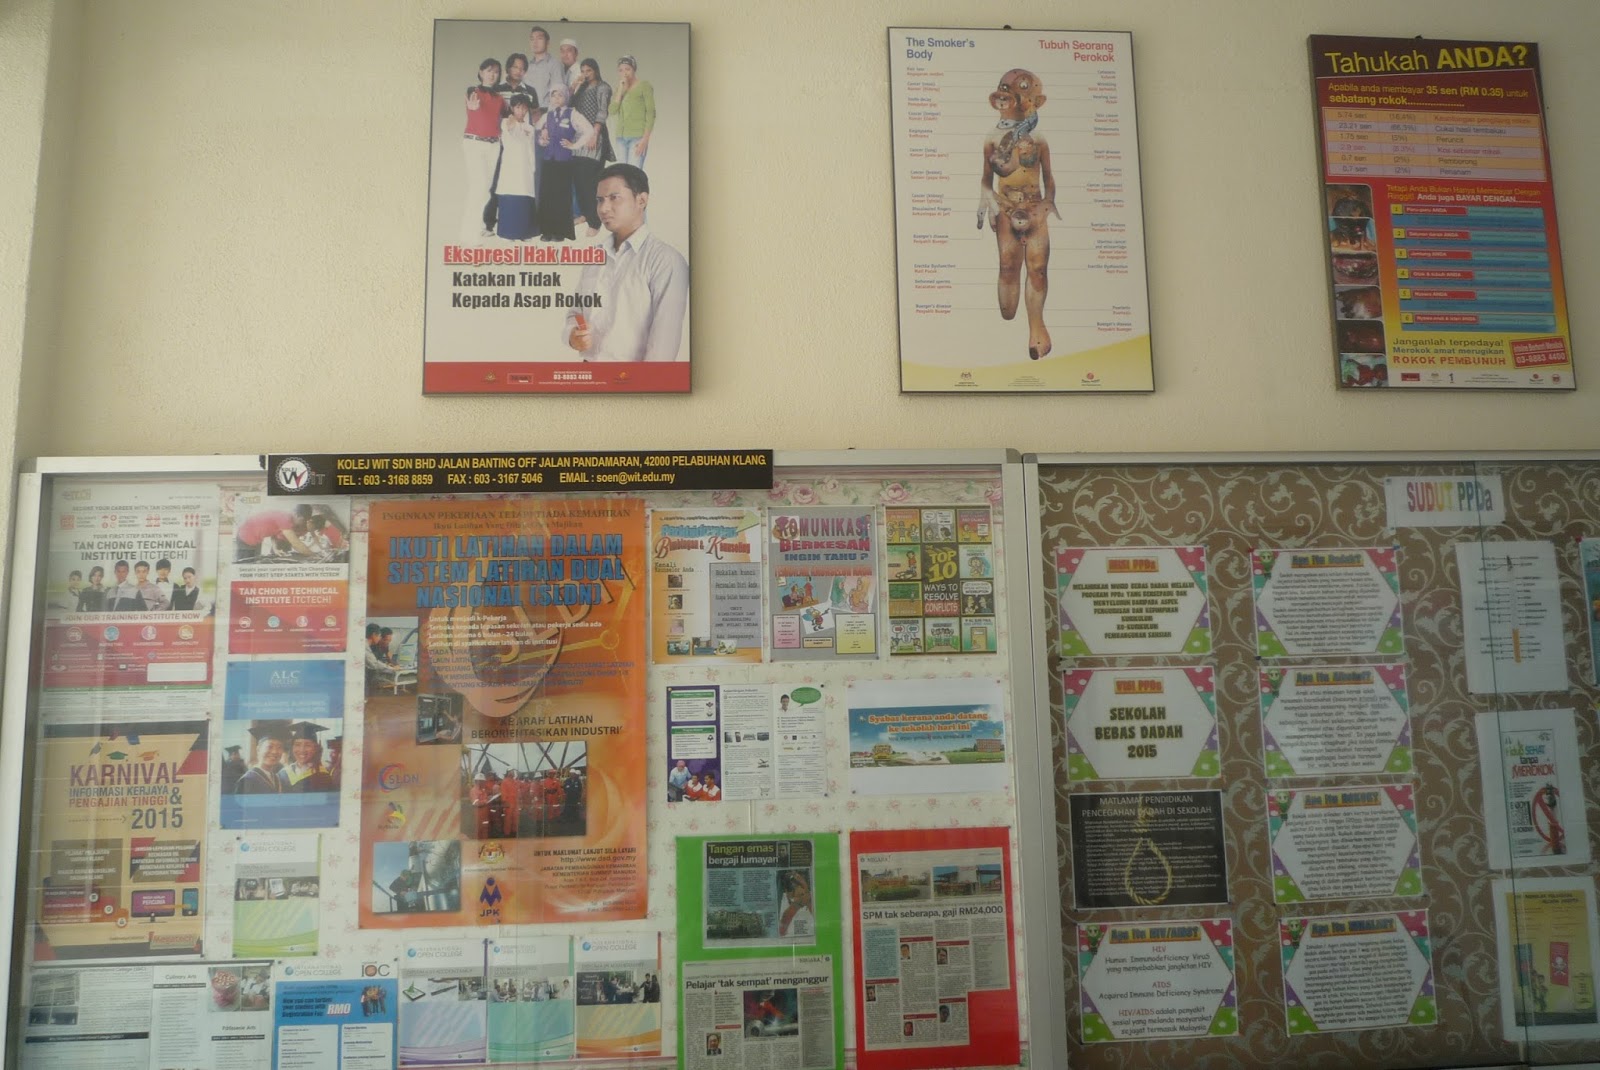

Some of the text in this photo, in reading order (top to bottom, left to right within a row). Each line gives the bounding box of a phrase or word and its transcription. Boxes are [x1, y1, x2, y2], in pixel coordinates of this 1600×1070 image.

[906, 37, 975, 48] The Smoker's
[1039, 40, 1114, 52] Tubuh Seorang
[907, 50, 933, 59] Body
[1074, 52, 1114, 62] Perokok
[1325, 45, 1527, 73] Tahukah ANDA?
[1328, 83, 1359, 92] Apabila
[1360, 84, 1380, 92] anda
[1382, 85, 1424, 95] membayar
[1426, 85, 1437, 94] 35
[1460, 87, 1479, 97] (RM
[1481, 88, 1504, 97] 0.35)
[1507, 90, 1528, 98] untuk
[1330, 94, 1376, 105] sebatang
[1418, 193, 1436, 201] Anda
[1438, 194, 1454, 202] juga
[444, 246, 605, 265] Ekspresi Hak Anda
[453, 272, 561, 286] Katakan Tidak
[452, 293, 602, 309] Kepada Asap Rokok
[1393, 338, 1446, 348] Janganlah
[1450, 339, 1503, 348] terpedaya!
[1393, 346, 1431, 354] Merokok
[1458, 347, 1504, 355] merugikan
[1393, 355, 1506, 366] ROKOK PEMBUNUH
[337, 455, 766, 469] KOLEJ WIT SDN BHD JALAN BANTING OFF JALAN PANDAMARAN, 42000 PELABUHAN KLANG
[337, 474, 433, 486] TEL 603 3168 8859
[448, 473, 543, 484] FAX 603 3167 5046
[560, 472, 675, 485] EMAIL soen@wit.edu.my
[1407, 482, 1493, 512] SUDUT PPDa
[568, 509, 631, 518] KEMAHIRAN
[73, 540, 197, 550] TAN CHONG TECHNICAL
[390, 533, 622, 559] IKUTI LATIHAN DALAM
[780, 538, 870, 552] BERKESAN
[81, 551, 137, 560] INSTITUTE
[785, 553, 856, 561] INGIN TAHU
[930, 550, 956, 564] TOP
[387, 558, 624, 584] SISTEM LATIHAN DUAL
[928, 561, 957, 582] 10
[240, 587, 338, 595] TAN CHONG TECHNICAL
[417, 583, 601, 609] NASIONAL (SLDN)
[245, 596, 291, 604] INSTITUTE
[925, 602, 959, 612] CONFLICTS
[271, 670, 299, 679] ALC
[548, 714, 593, 725] LATIHAN
[869, 715, 900, 723] Syabas
[935, 713, 955, 721] anda
[957, 712, 988, 720] datang
[1110, 707, 1166, 720] SEKOLAH
[471, 727, 568, 739] BERORIENTASIKAN
[902, 724, 935, 732] sekolah
[1095, 725, 1183, 740] BEBAS DADAH
[1128, 745, 1157, 758] 2015
[70, 762, 184, 787] KARNIVAL
[389, 774, 419, 785] SLDN
[69, 786, 182, 805] INFORMASI KERJAYA &
[69, 795, 167, 808] PENGAJIAN TINGGI
[1100, 795, 1193, 805] MATLAMAT PENDIDIKAN
[1082, 809, 1136, 817] PENCEGAHAN
[1177, 806, 1211, 814] SEKOLAH
[132, 807, 183, 829] 2015
[708, 844, 774, 856] Tangan emas
[708, 855, 779, 866] bergaji lumayan
[480, 909, 499, 917] JPK
[863, 906, 1003, 919] SPM tak seberapa, gaji RM24,000
[361, 964, 389, 977] IOC
[1123, 964, 1166, 972] menyebabkan
[1168, 964, 1197, 972] jangkitan
[686, 976, 828, 990] Pelajar menganggur
[1099, 992, 1128, 1000] Acquired
[1193, 988, 1224, 996] Syndrome
[1119, 1008, 1154, 1016] HIV/AIDS
[1179, 1006, 1205, 1014] penyakit
[1112, 1018, 1130, 1026] sosial
[1176, 1015, 1212, 1024] masyarakat
